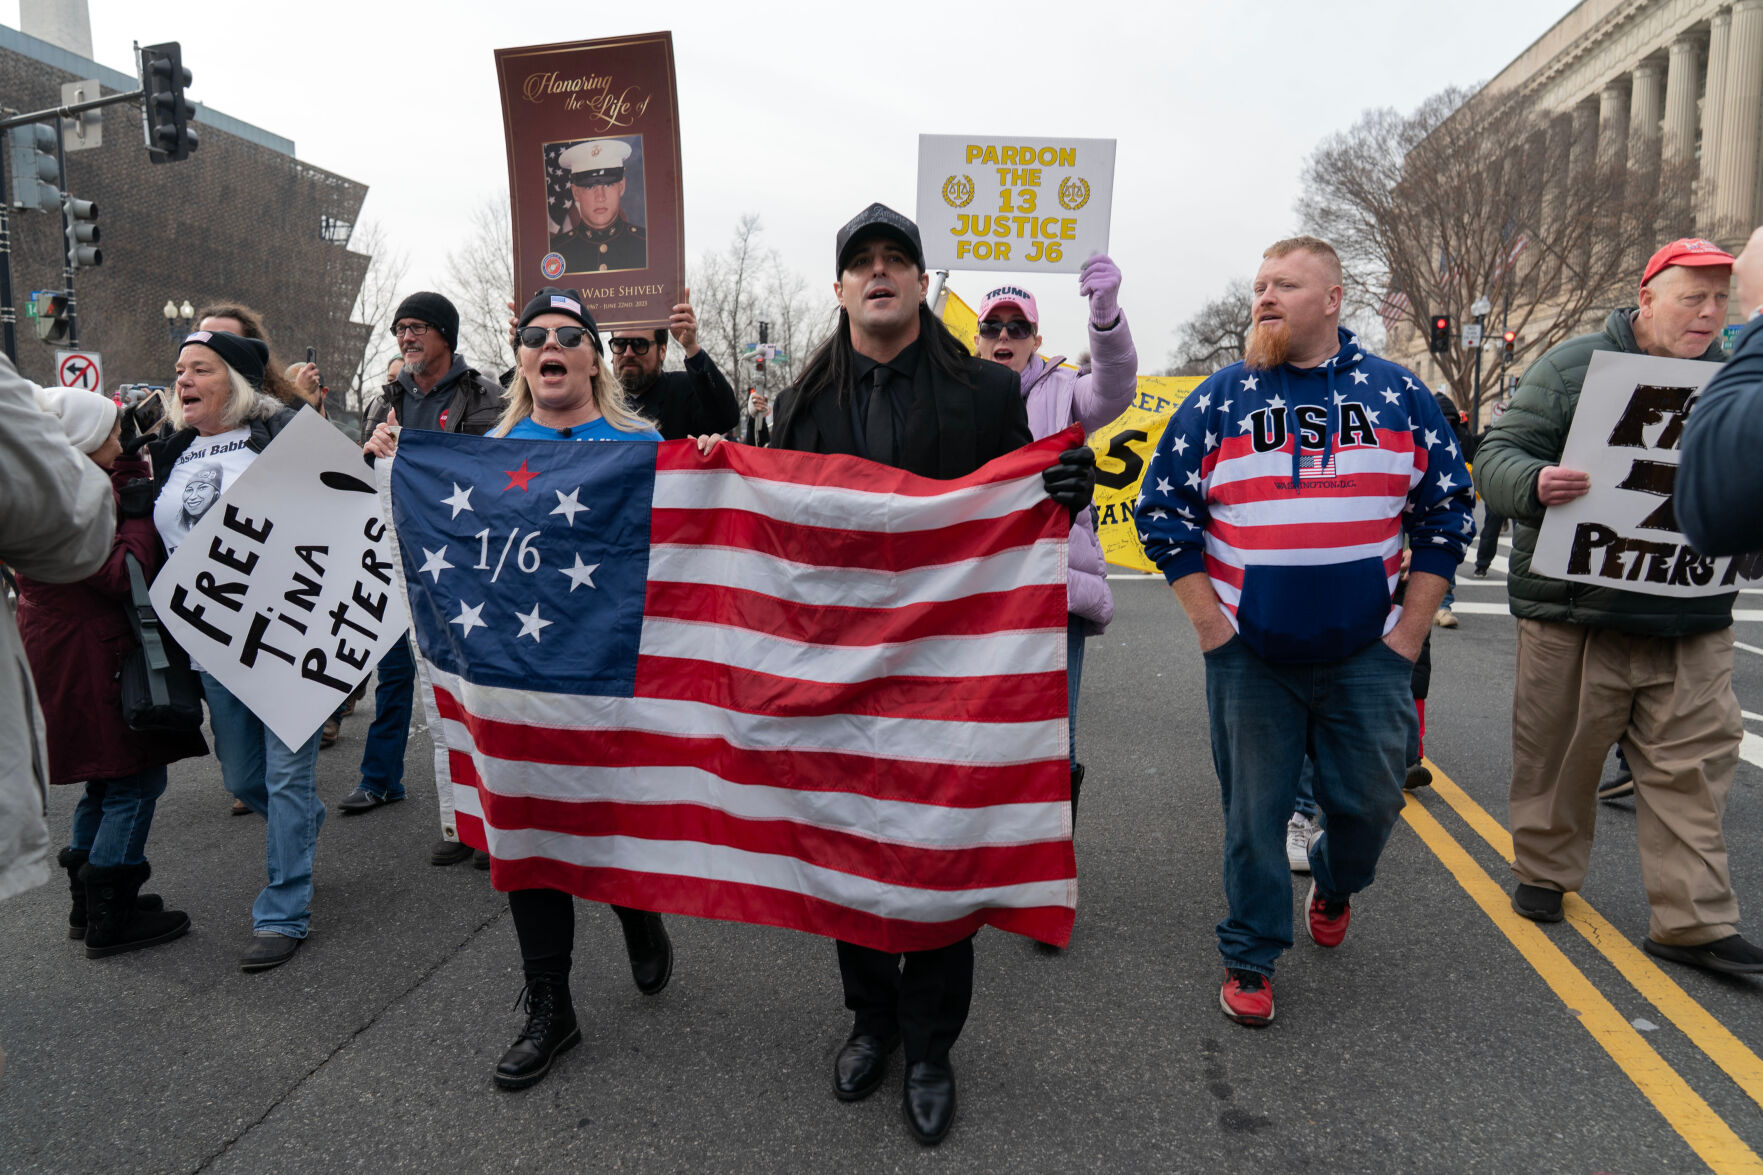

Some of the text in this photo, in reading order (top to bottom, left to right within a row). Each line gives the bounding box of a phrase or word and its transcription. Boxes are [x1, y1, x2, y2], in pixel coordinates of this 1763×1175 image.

[523, 71, 612, 103] Honoring
[564, 85, 654, 133] the Life of
[965, 144, 1077, 167] PARDON
[996, 168, 1042, 188] THE
[998, 188, 1038, 214] 13
[950, 213, 1078, 241] JUSTICE
[956, 240, 1063, 263] FOR J6
[618, 284, 665, 297] SHIVELY
[986, 286, 1031, 300] TRUMP
[1250, 401, 1380, 453] USA
[473, 527, 542, 584] 1/6
[1567, 522, 1715, 586] PETERS
[170, 503, 274, 647] FREE
